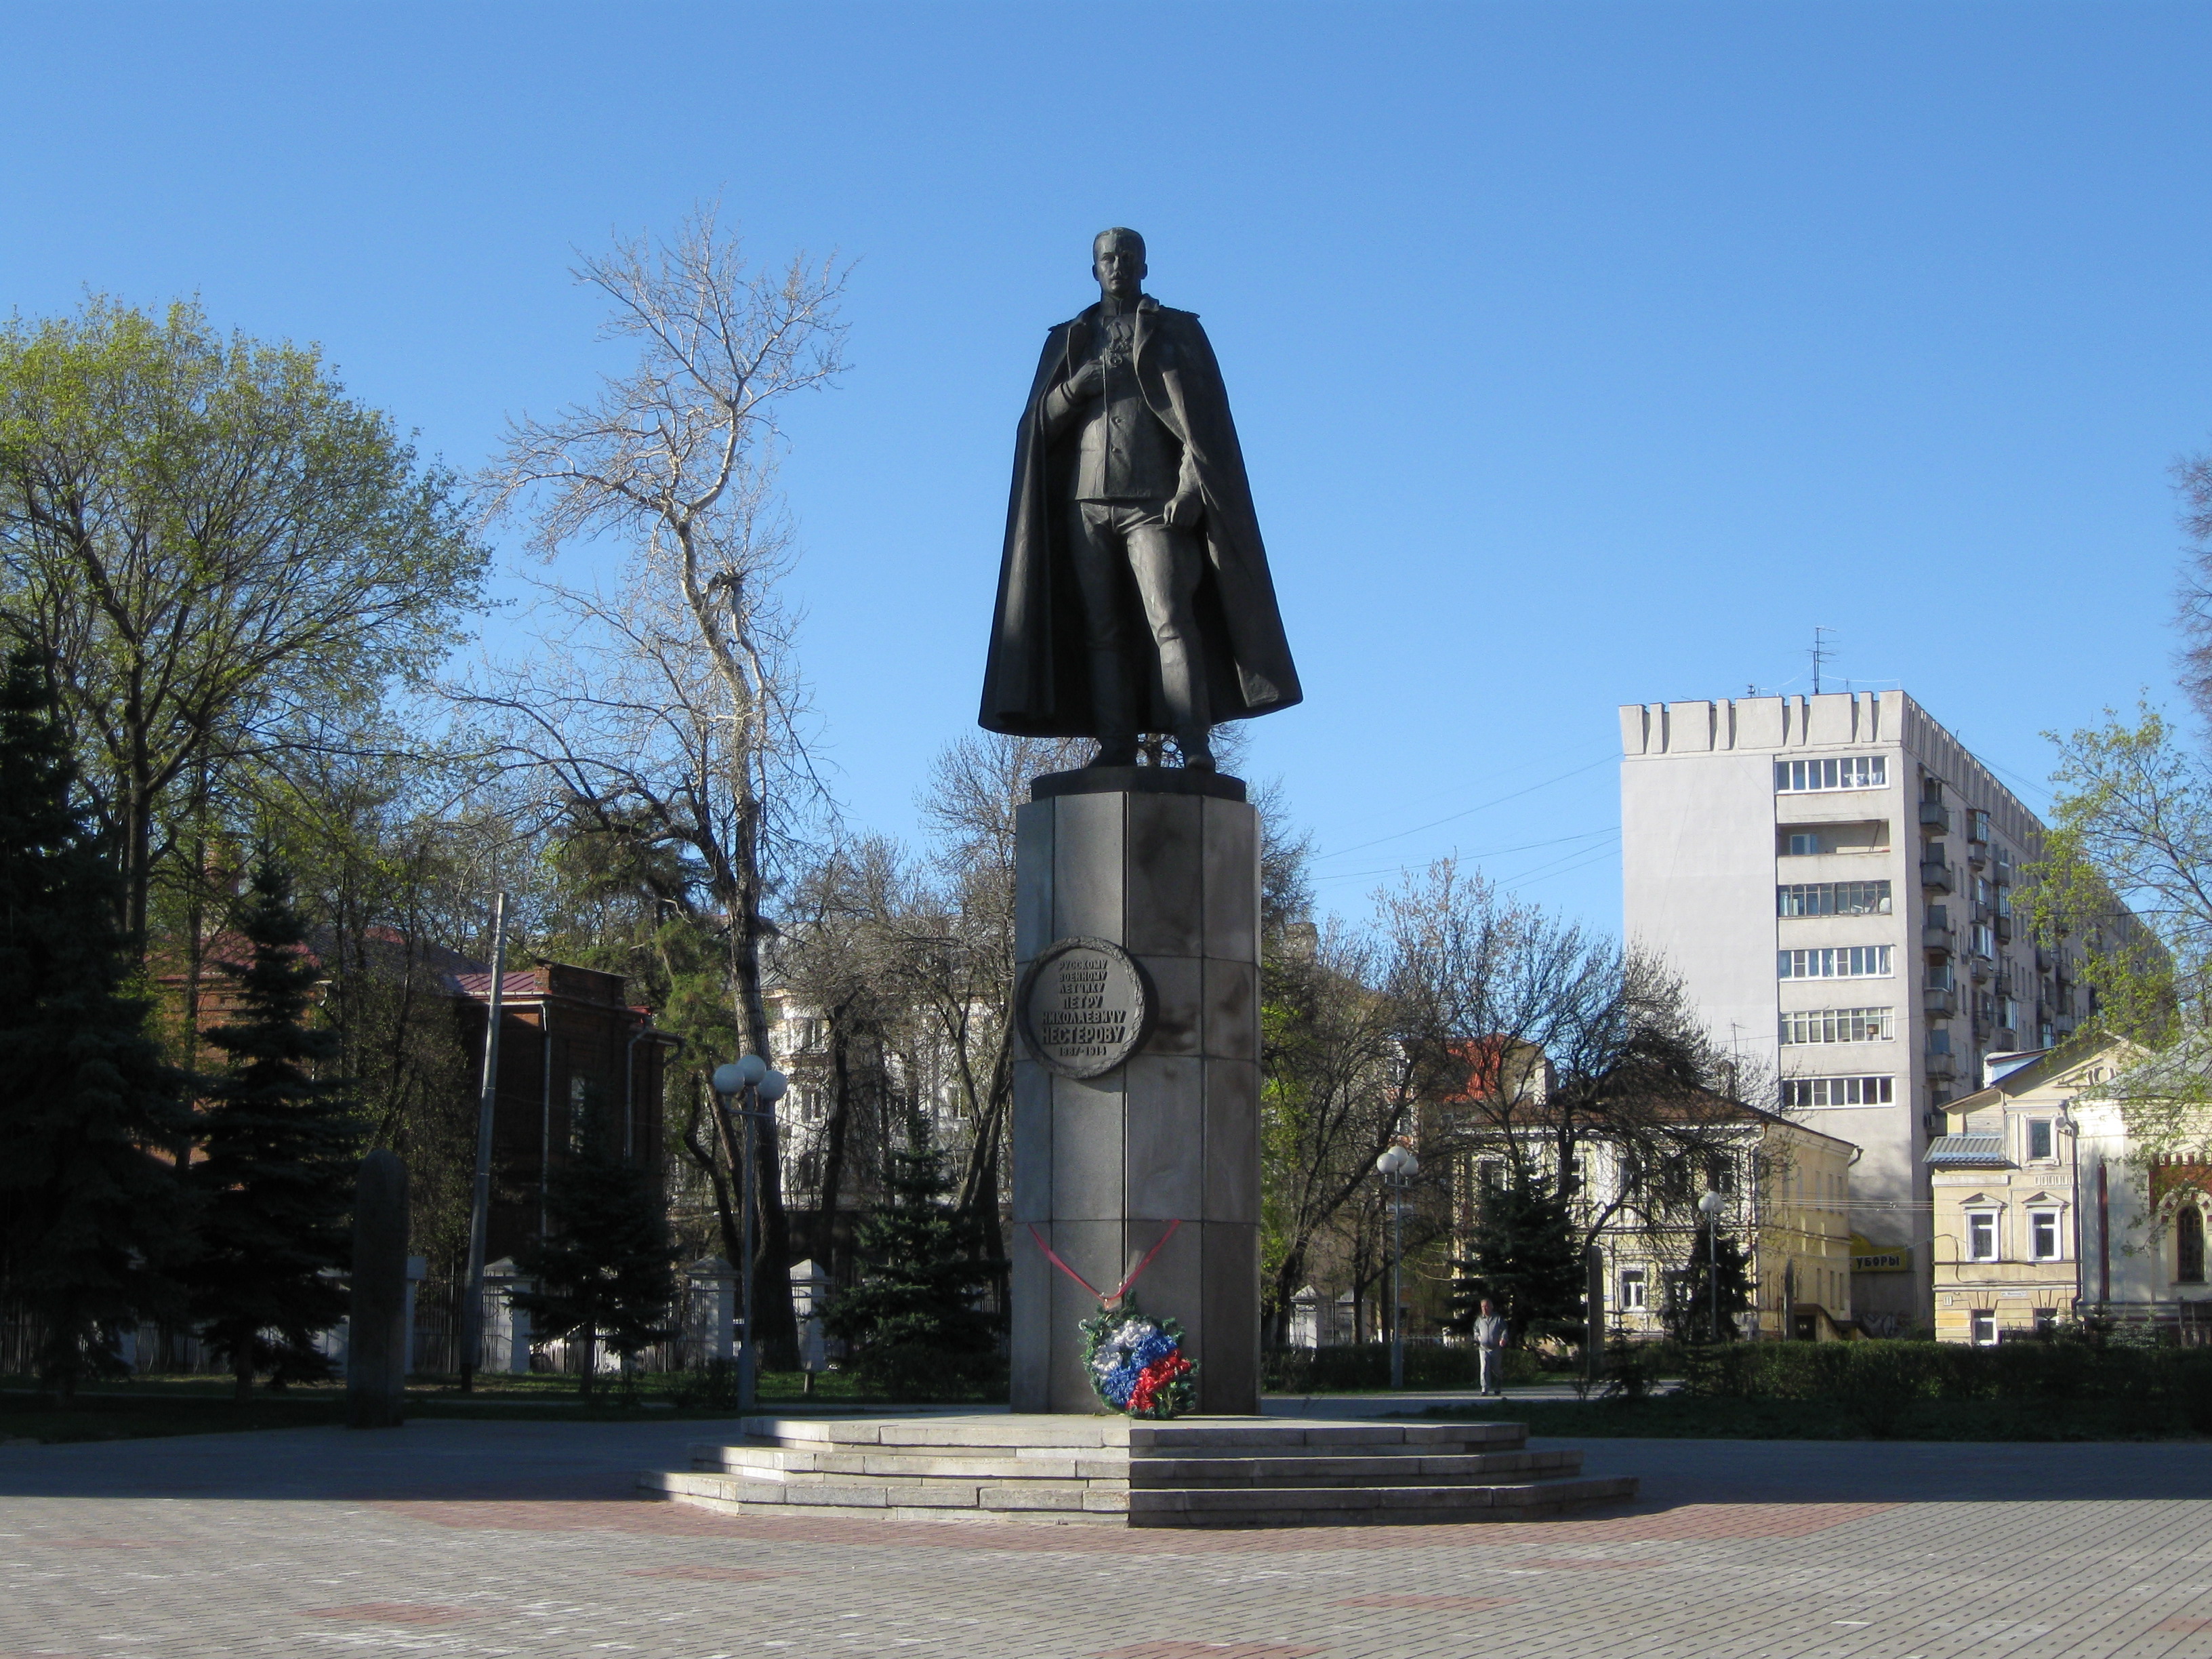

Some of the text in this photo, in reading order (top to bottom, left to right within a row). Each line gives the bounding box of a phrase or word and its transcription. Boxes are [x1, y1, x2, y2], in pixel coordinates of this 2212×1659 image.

[1059, 960, 1107, 970] РУССКОМУ
[1059, 971, 1107, 982] ВОЕННОМУ
[1060, 983, 1105, 994] ЛЕТЧИКУ
[1063, 996, 1104, 1010] ПЕТРУ
[1042, 1010, 1126, 1025] НИКОЛАЕВИЧУ
[1042, 1025, 1126, 1044] НЕСТЕРОВУ
